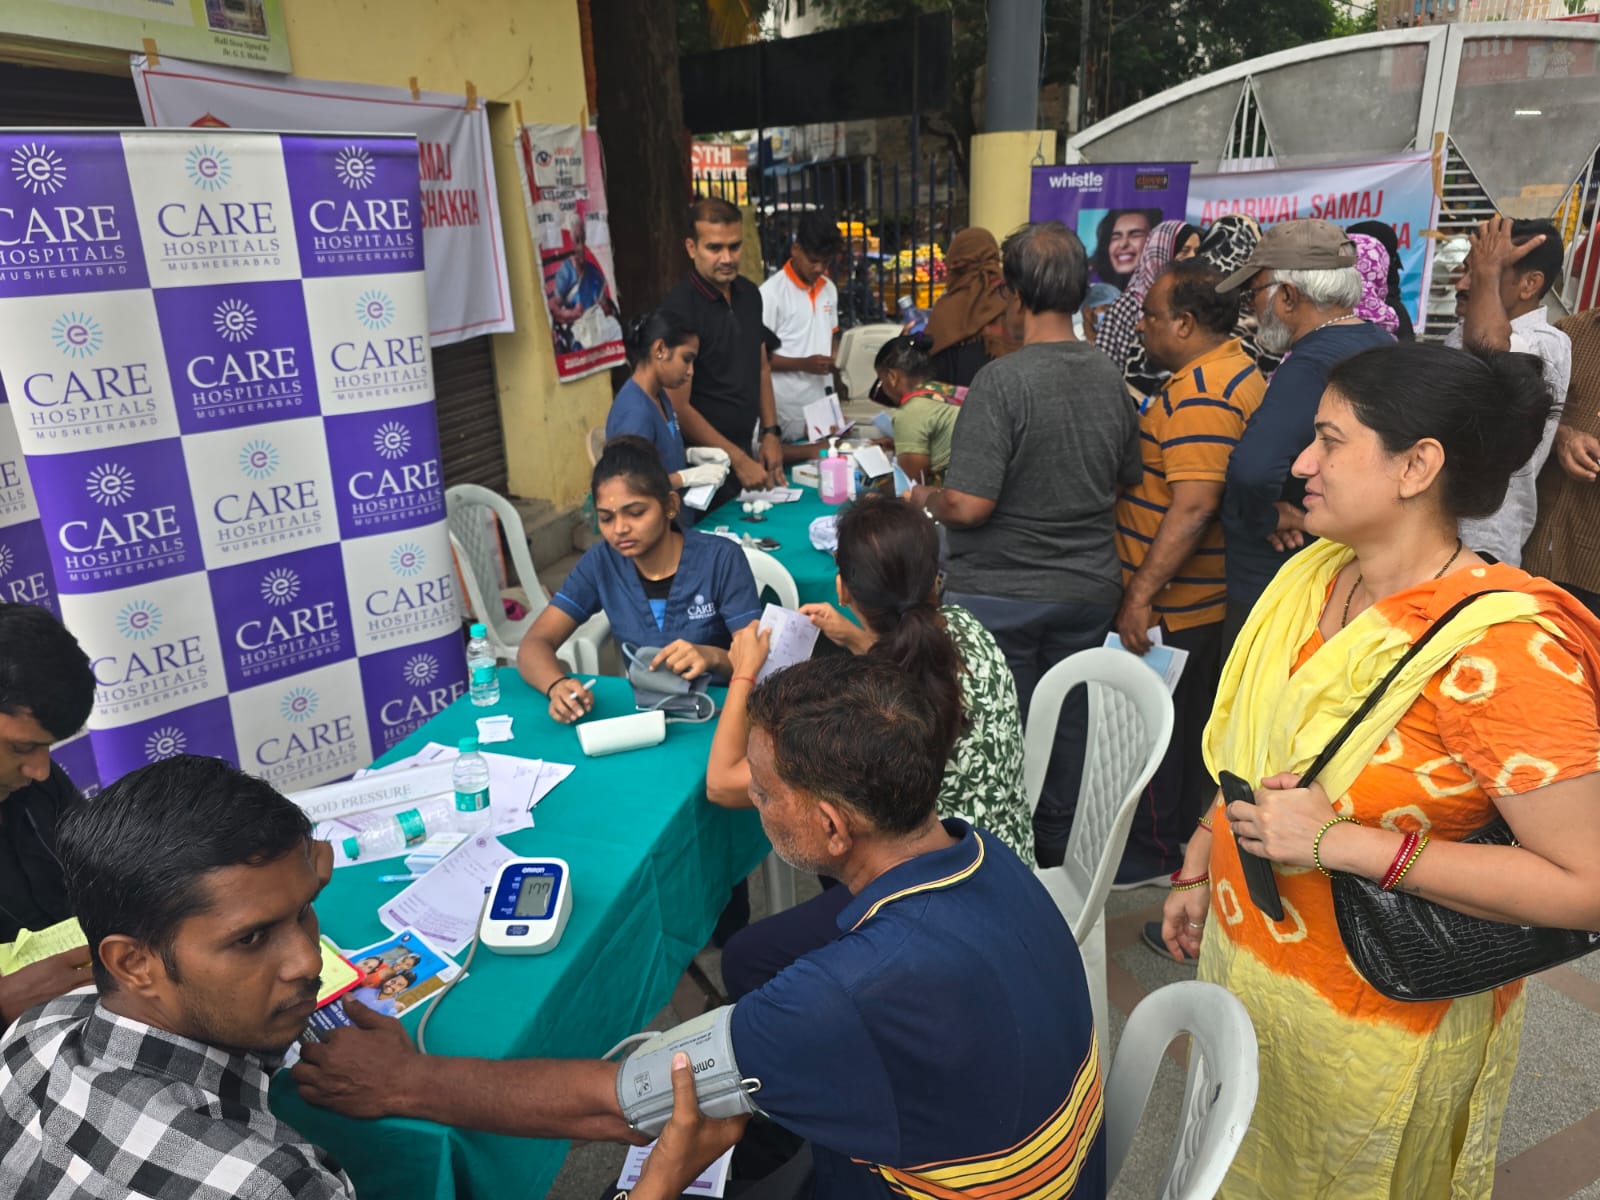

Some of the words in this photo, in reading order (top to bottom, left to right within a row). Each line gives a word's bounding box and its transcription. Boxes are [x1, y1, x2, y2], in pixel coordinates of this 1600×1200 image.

[418, 142, 453, 181] MAJ
[1049, 171, 1103, 188] whistle
[158, 202, 276, 238] CARE
[309, 199, 412, 233] CARE
[1201, 196, 1304, 227] AGARWAL
[1309, 190, 1383, 220] SAMAJ
[0, 205, 120, 246] CARE
[313, 233, 414, 250] HOSPITALS
[163, 238, 280, 256] HOSPITALS
[317, 252, 415, 263] MUSHEERABAD
[168, 257, 280, 271] MUSHEERABAD
[186, 347, 299, 388] CARE
[330, 335, 426, 372] CARE
[23, 363, 152, 407] CARE
[192, 380, 302, 406] HOSPITALS
[334, 366, 428, 388] HOSPITALS
[30, 398, 156, 425] HOSPITALS
[196, 398, 303, 418] MUSHEERABAD
[36, 417, 158, 439] MUSHEERABAD
[348, 459, 440, 500] CARE
[214, 480, 318, 524] CARE
[352, 488, 441, 515] HOSPITALS
[58, 505, 181, 553] CARE
[218, 510, 322, 541] HOSPITALS
[65, 537, 184, 569] HOSPITALS
[69, 554, 185, 581] MUSHEERABAD
[0, 572, 48, 605] RE
[365, 574, 453, 616] CARE
[236, 601, 338, 650] CARE
[368, 602, 455, 631] HOSPITALS
[89, 635, 205, 687] CARE
[240, 630, 339, 666] HOSPITALS
[95, 665, 207, 703] HOSPITALS
[256, 715, 354, 765] CARE
[304, 801, 338, 817] OOD
[342, 785, 412, 809] PRESSURE
[693, 1058, 715, 1074] OMR
